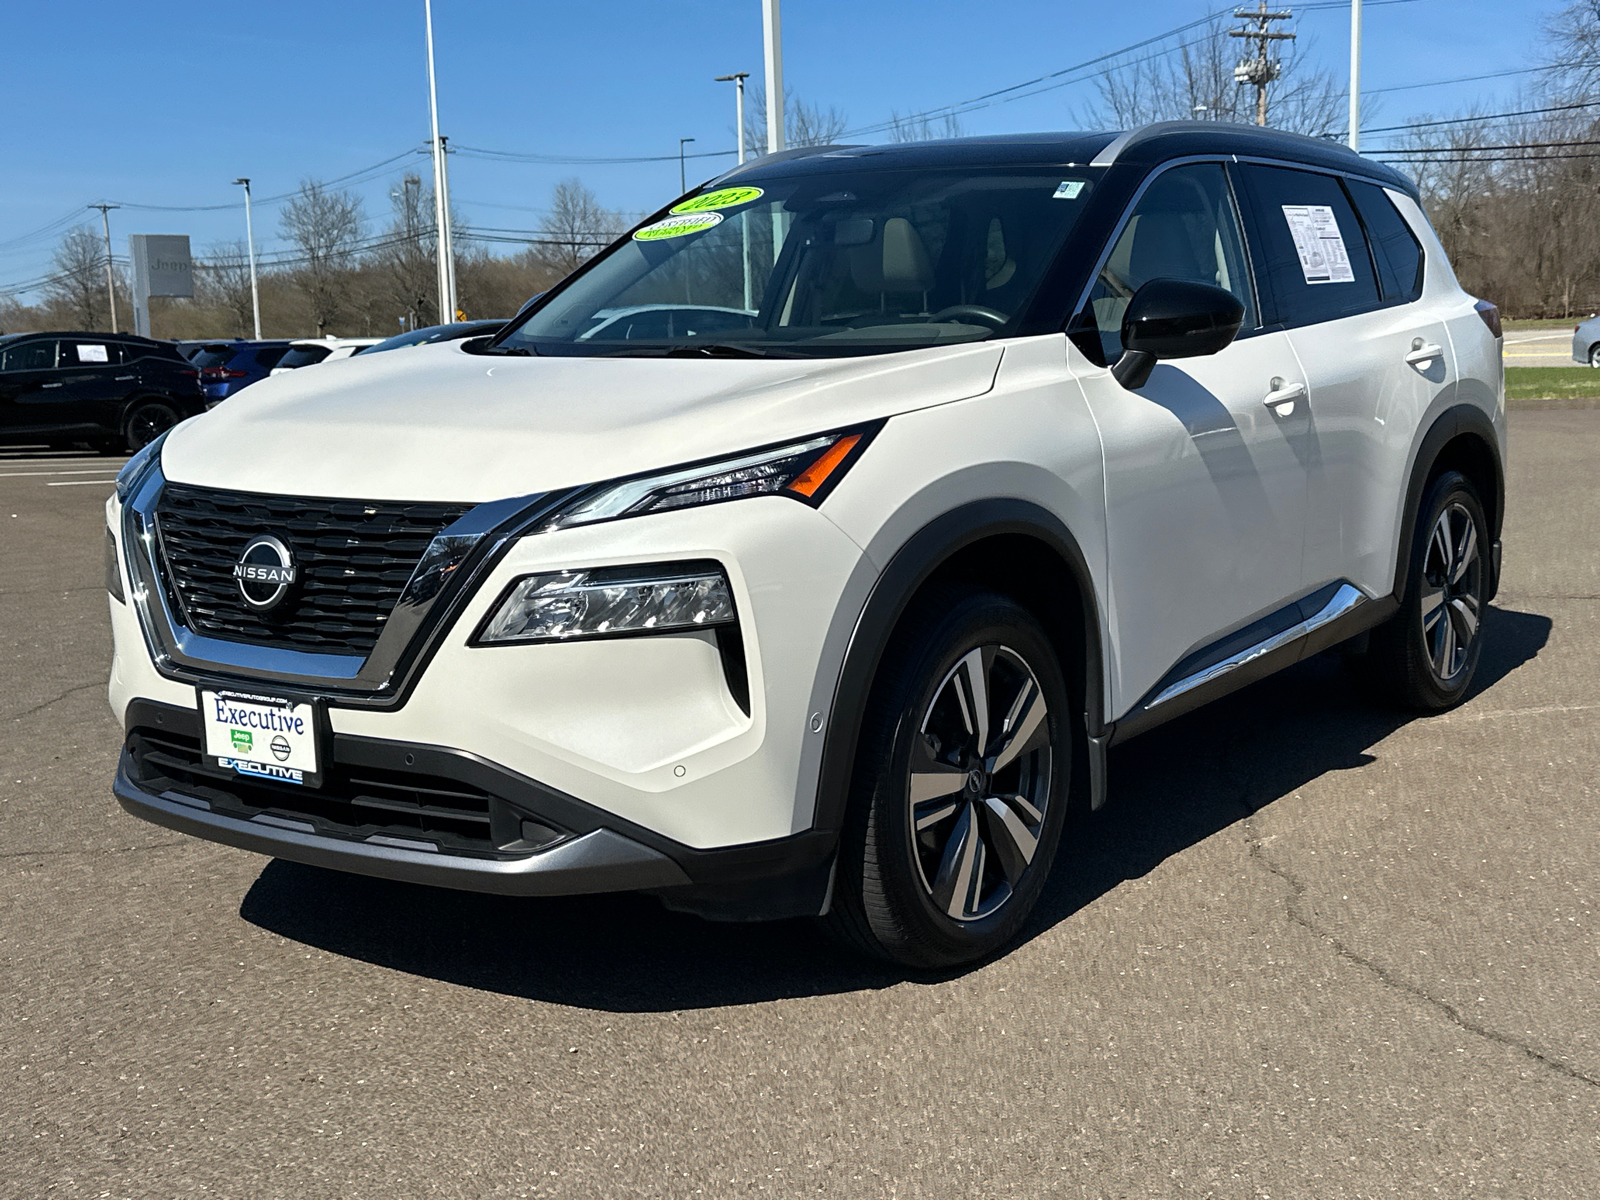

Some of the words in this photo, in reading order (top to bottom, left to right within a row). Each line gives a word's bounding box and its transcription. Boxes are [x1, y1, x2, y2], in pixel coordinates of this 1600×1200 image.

[679, 190, 752, 212] 2023
[150, 258, 188, 272] Jeep
[234, 564, 294, 582] NISSAN
[214, 697, 305, 736] Executive
[233, 730, 251, 742] Jeep
[217, 757, 304, 781] EXECUTIVE
